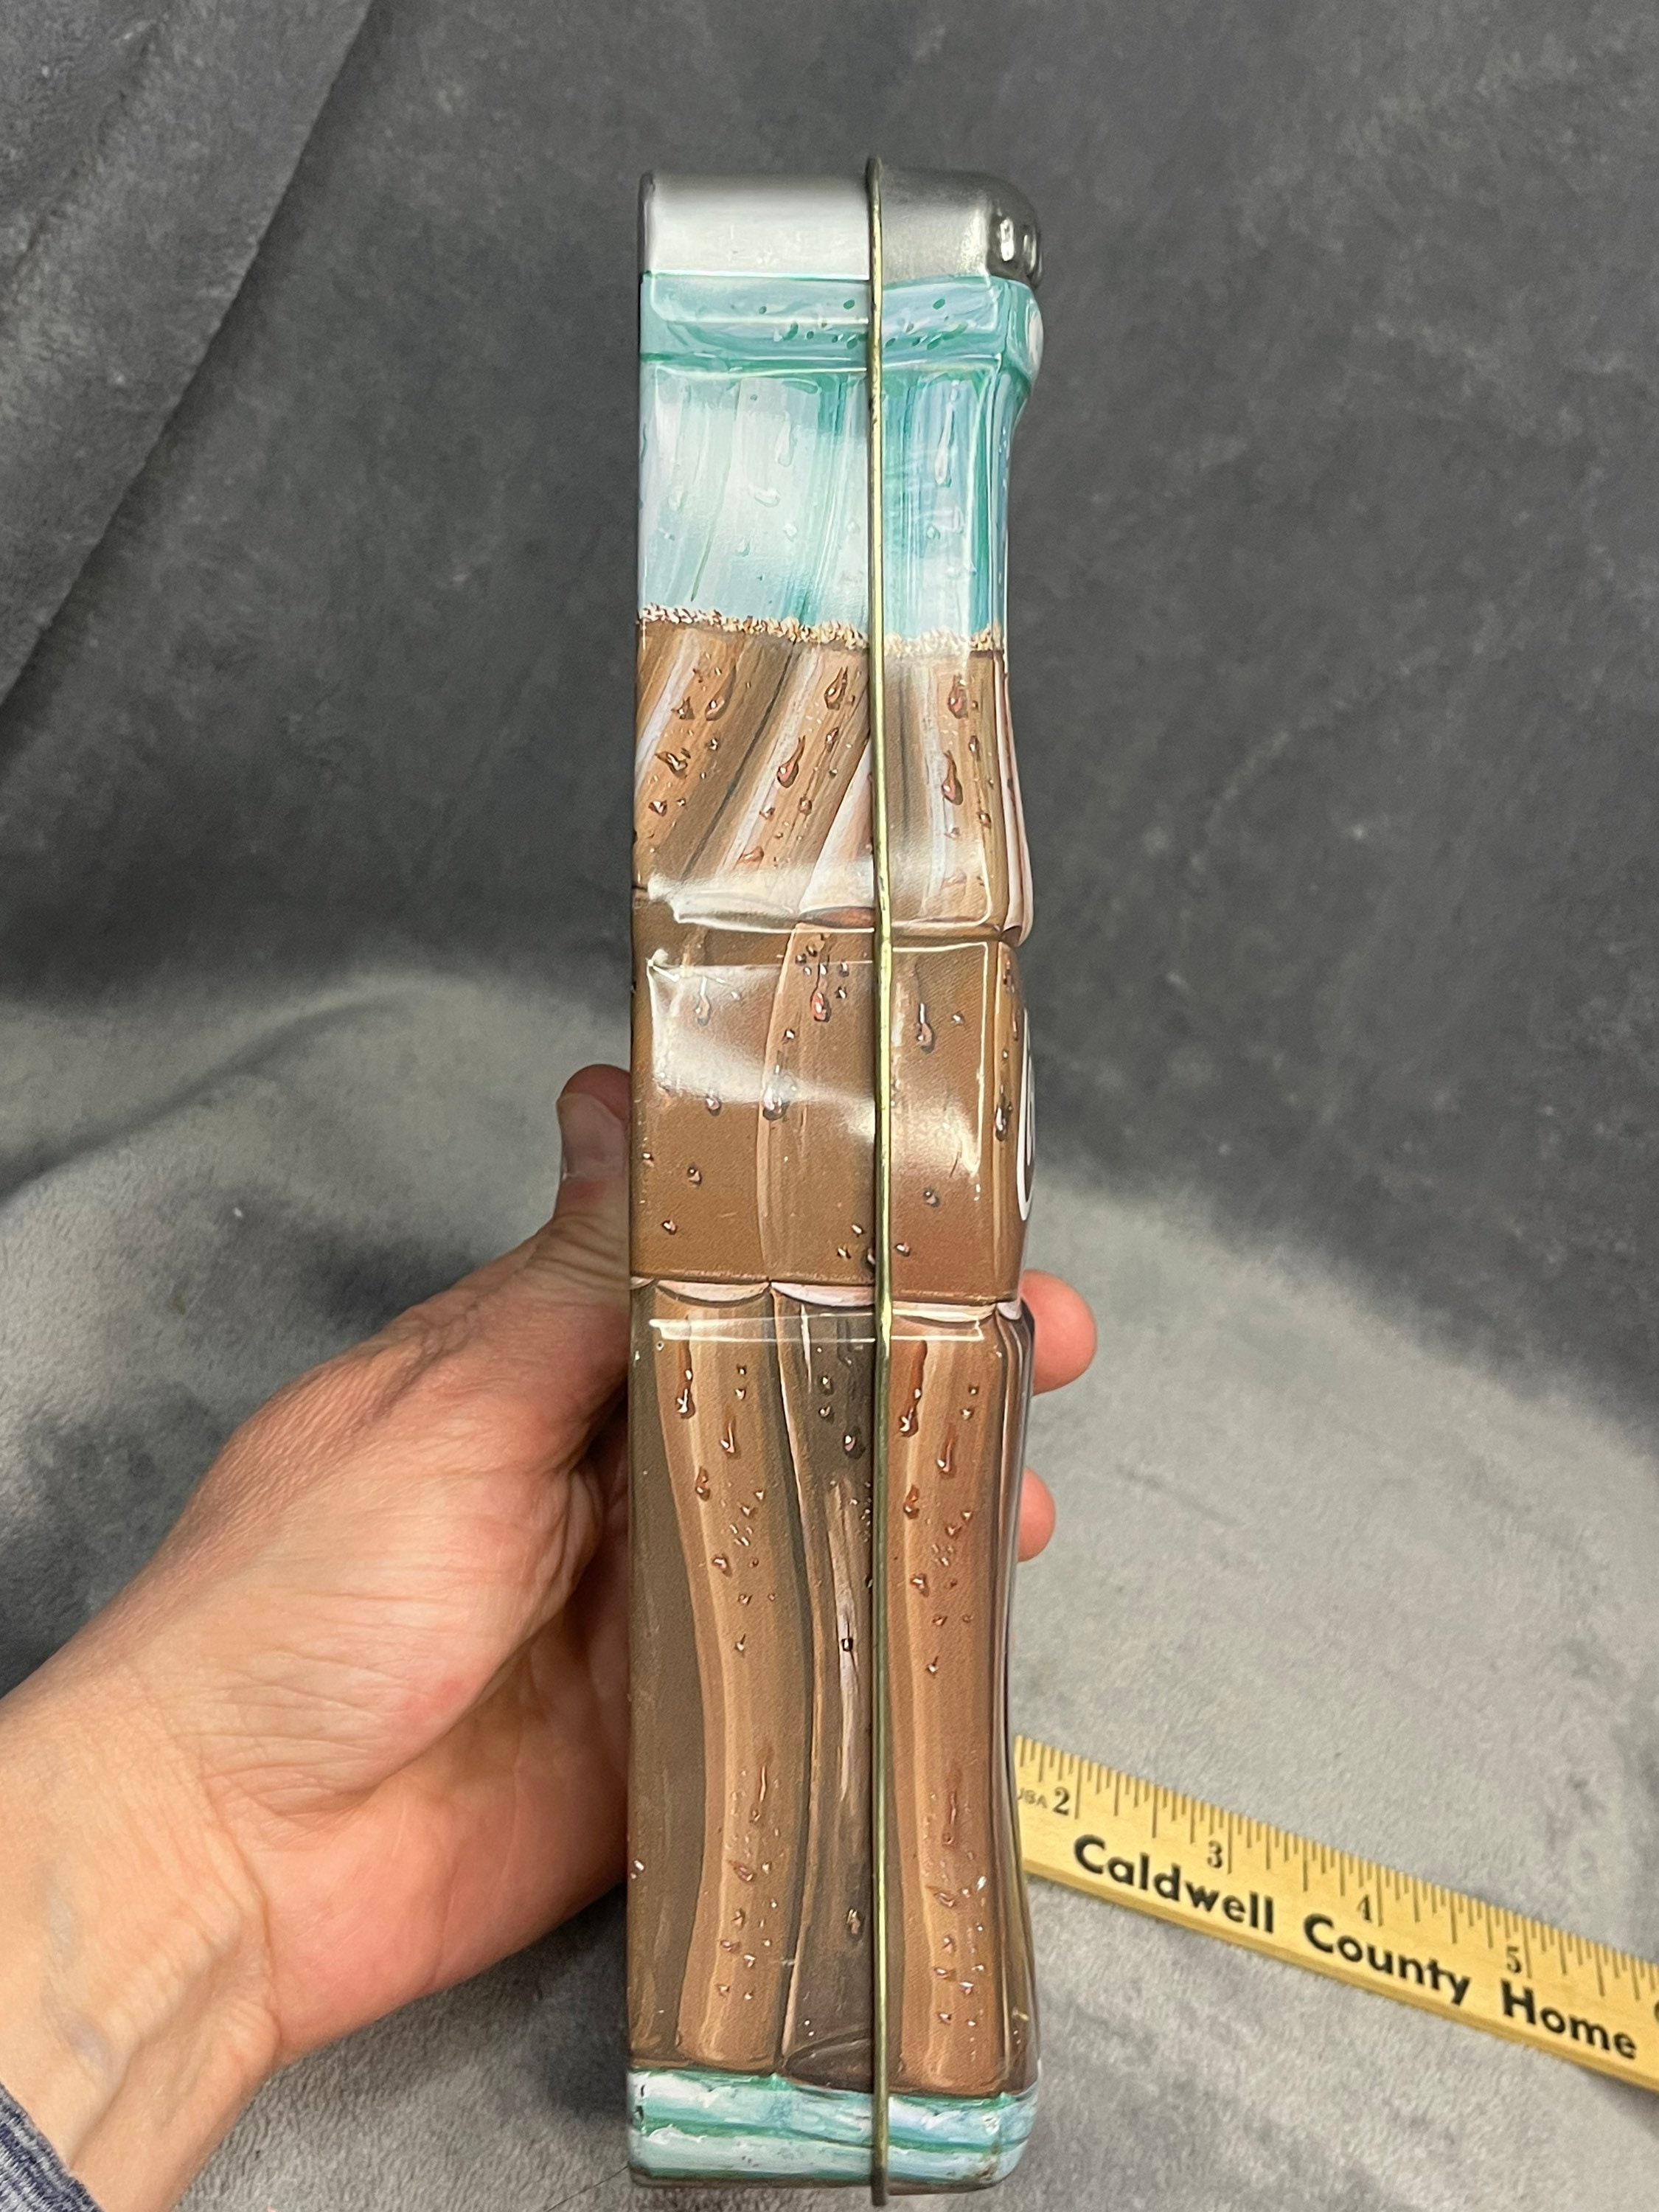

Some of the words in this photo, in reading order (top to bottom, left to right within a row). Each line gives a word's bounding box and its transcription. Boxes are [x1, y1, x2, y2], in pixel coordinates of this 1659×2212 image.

[1053, 1787, 1070, 1816] 2
[1207, 1840, 1224, 1869] 3
[1074, 1834, 1274, 1934] Caldwell
[1304, 1913, 1471, 2006] County
[1500, 1979, 1637, 2059] Home
[1506, 1946, 1523, 1975] 5
